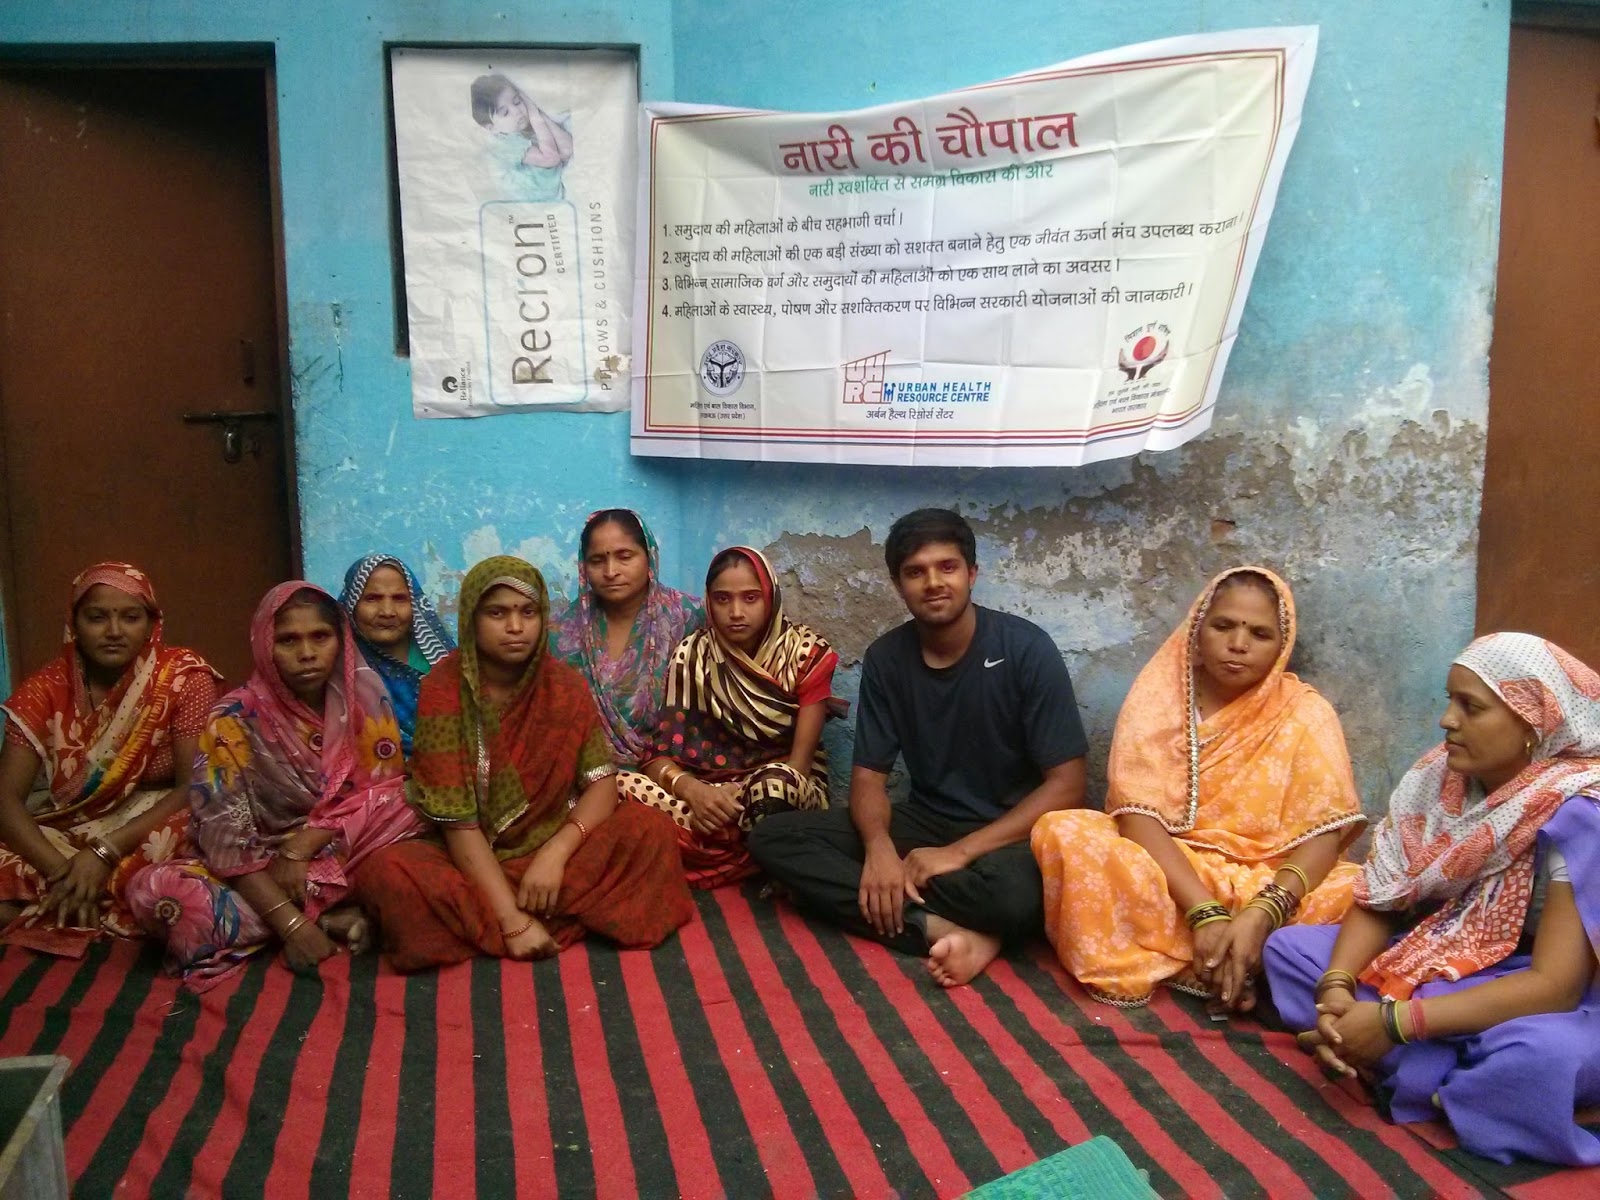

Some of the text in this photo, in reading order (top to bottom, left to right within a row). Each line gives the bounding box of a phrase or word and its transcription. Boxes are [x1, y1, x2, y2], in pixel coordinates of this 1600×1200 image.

[779, 107, 1080, 173] नारी की चौपाल
[809, 179, 834, 198] नारी
[838, 175, 889, 195] स्वशक्ति
[951, 169, 996, 187] विकास
[663, 224, 672, 238] 1.
[674, 224, 712, 241] समुदाय
[715, 221, 731, 236] की
[735, 218, 784, 236] महिलाओं
[787, 217, 799, 233] के
[801, 216, 822, 232] बीच
[825, 211, 870, 230] सहभागी
[547, 214, 565, 274] CERTIFIED
[589, 201, 606, 291] CUSHIONS
[662, 251, 672, 265] 2.
[674, 251, 709, 267] समुदाय
[713, 247, 728, 262] की
[731, 245, 781, 264] महिलाओं
[785, 245, 800, 261] की
[803, 247, 823, 260] एक
[826, 243, 846, 261] बड़ी
[850, 241, 882, 258] संख्या
[885, 239, 901, 256] को
[904, 239, 944, 255] सशक्त
[947, 232, 981, 251] बनाने
[986, 231, 1005, 254] हेतु
[1009, 235, 1031, 248] एक
[1035, 227, 1070, 246] जीवंत
[1074, 222, 1108, 241] ऊर्जा
[1111, 221, 1136, 239] मंच
[1140, 222, 1195, 239] उपलब्ध
[662, 278, 672, 291] 3.
[674, 273, 709, 292] विभिन्न
[710, 273, 764, 290] सामाजिक
[767, 271, 784, 288] वर्ग
[787, 272, 810, 288] और
[812, 270, 858, 291] समुदायों
[861, 269, 877, 285] की
[938, 265, 954, 282] को
[957, 267, 979, 281] एक
[982, 263, 1008, 277] साथ
[1012, 258, 1039, 277] लाने
[1042, 260, 1061, 275] का
[511, 222, 553, 385] Recron
[595, 299, 608, 310] &
[662, 303, 672, 317] 4.
[674, 300, 716, 318] महिलाओं
[719, 300, 731, 316] के
[733, 302, 777, 318] स्वास्थ्य,
[781, 298, 811, 315] पोषण
[814, 298, 837, 315] और
[840, 296, 911, 314] सशक्तिकरण
[914, 298, 930, 312] पर
[933, 293, 976, 311] विभिन्न
[980, 292, 1028, 309] सरकारी
[1031, 287, 1097, 307] योजनाओं
[1101, 288, 1121, 304] की
[897, 392, 989, 402] RESOURCE CENTRE
[898, 382, 991, 392] URBAN HEALTH
[866, 407, 954, 420] अर्बन हैल्थ रिसोर्स सेंटर
